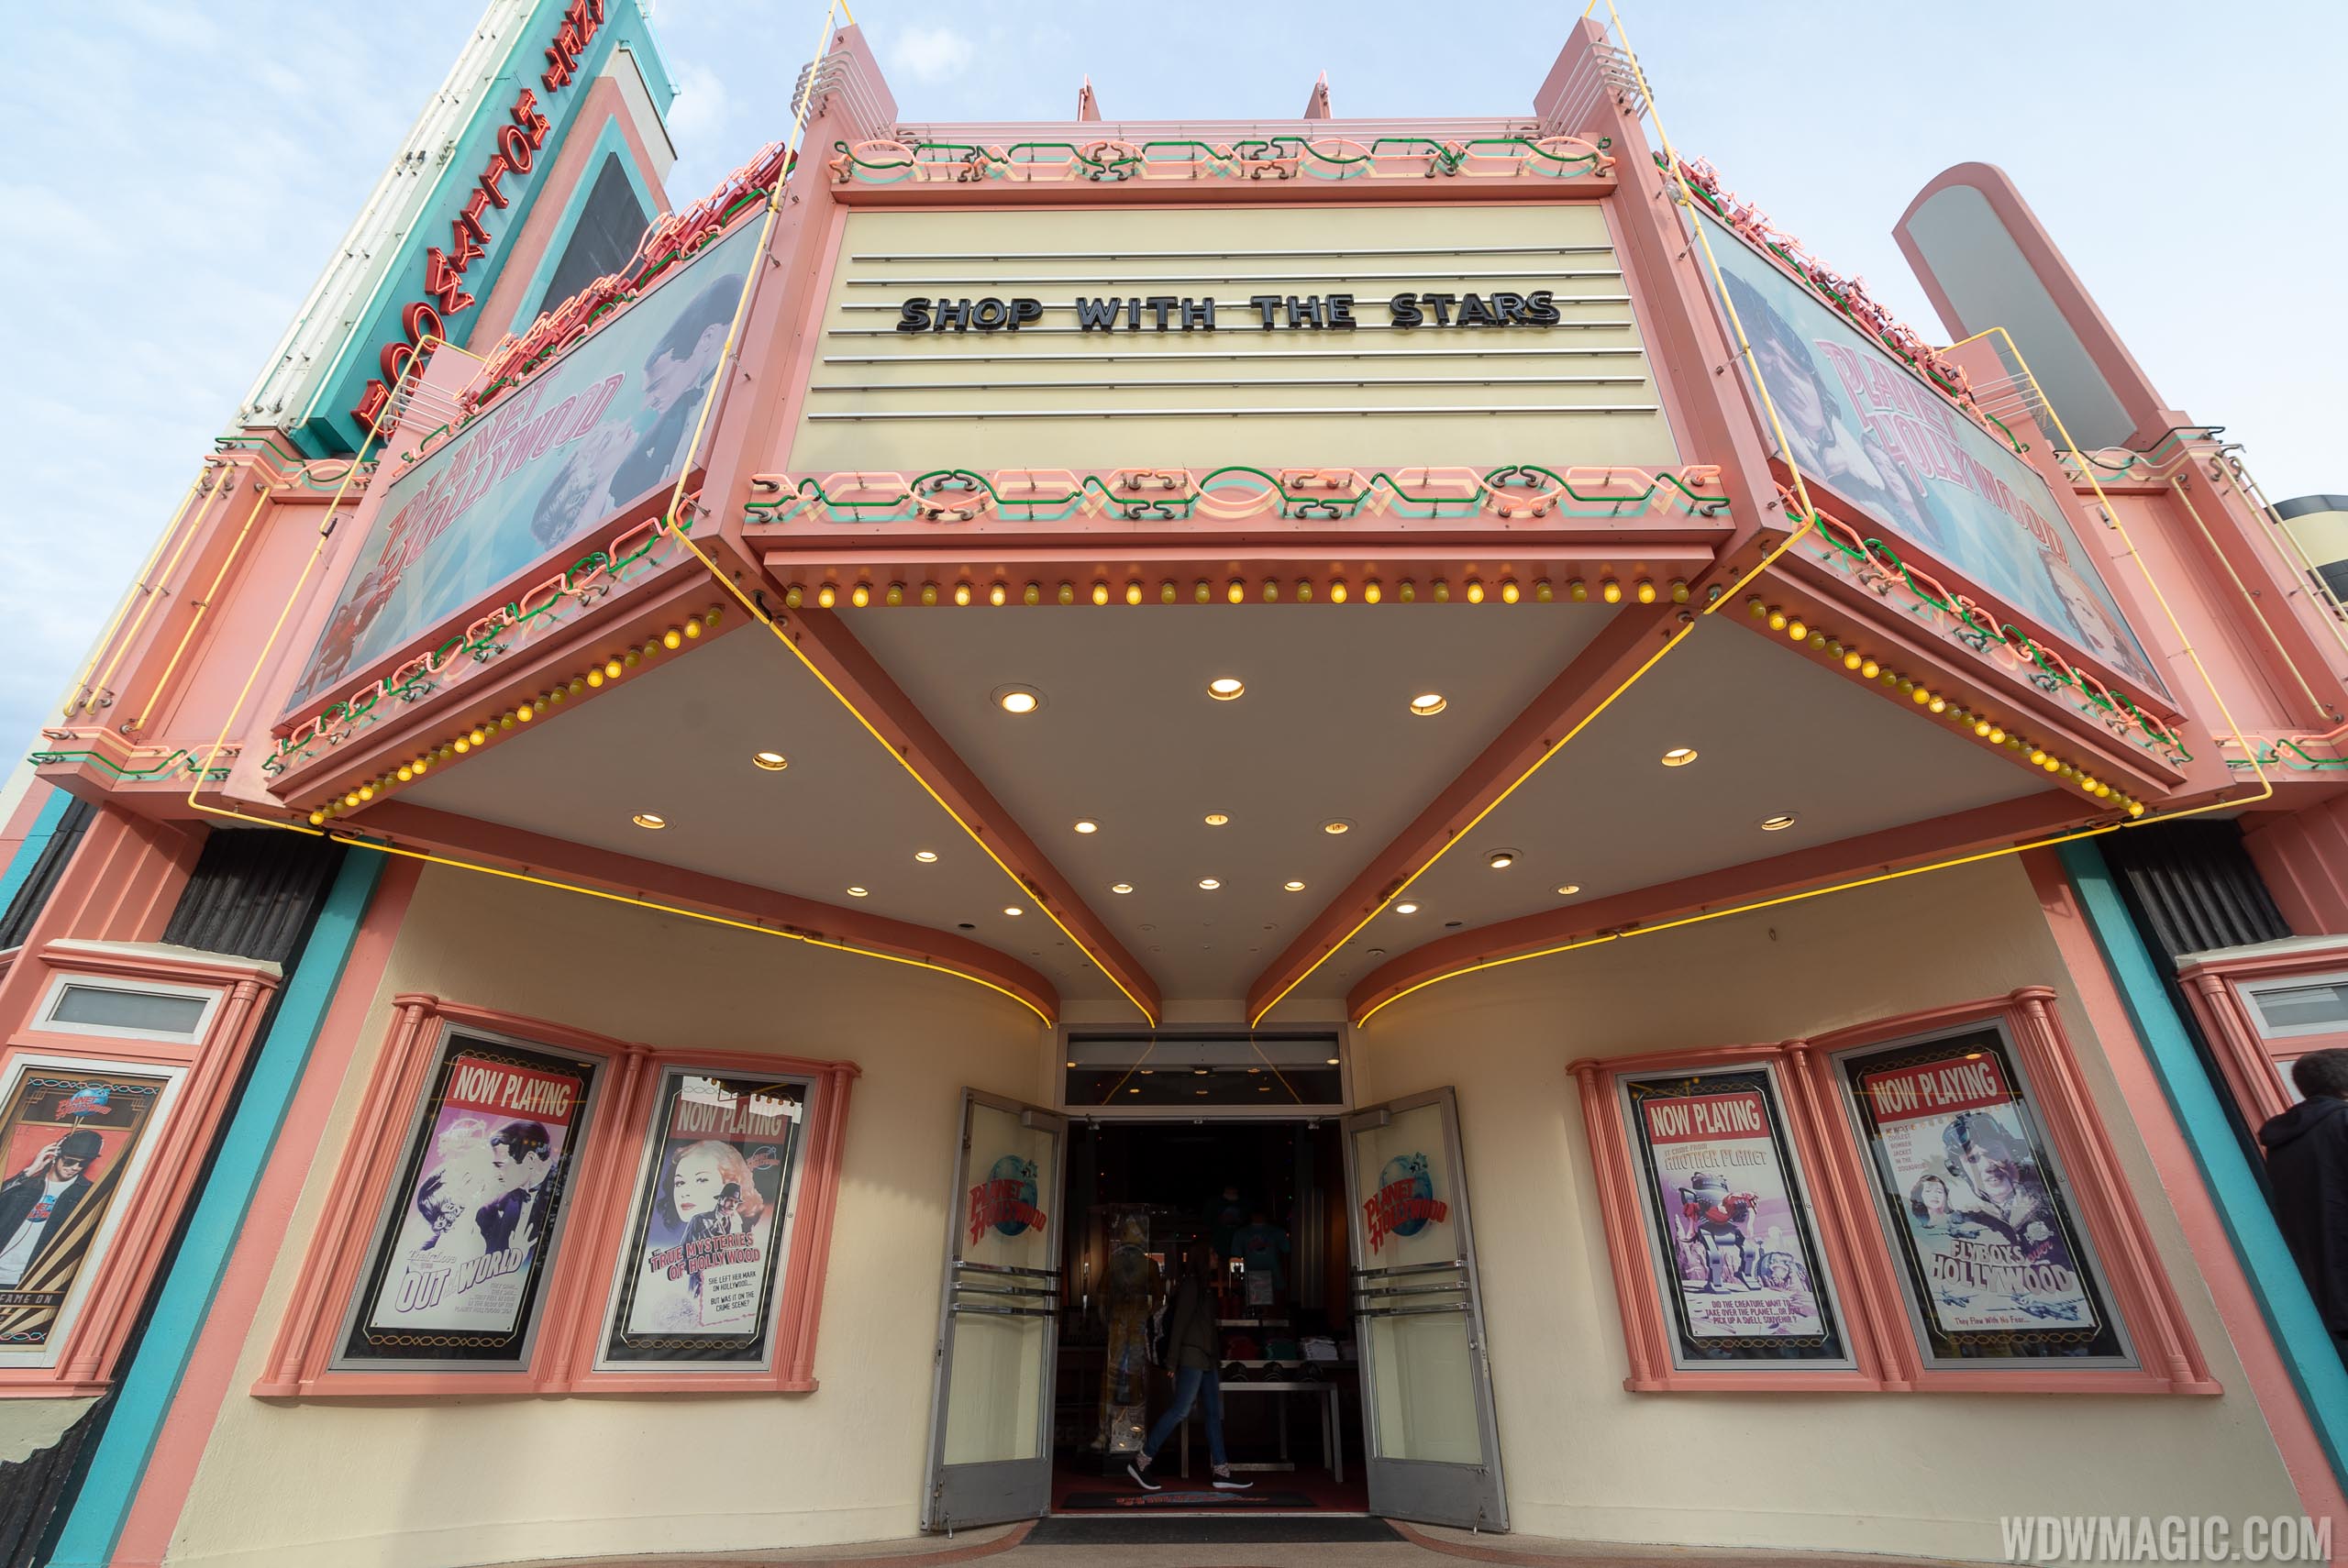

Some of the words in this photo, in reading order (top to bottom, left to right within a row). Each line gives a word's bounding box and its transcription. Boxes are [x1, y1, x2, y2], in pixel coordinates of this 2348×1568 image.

[896, 297, 1044, 333] SHOP
[1076, 296, 1216, 332] WITH
[1250, 293, 1357, 331] THE
[1390, 290, 1561, 327] STARS
[1813, 338, 1960, 444] PLANET
[377, 365, 564, 558] PLANET
[379, 372, 626, 587] HOLLYWOOD
[1866, 414, 2071, 568] HOLLYWOOD
[453, 1066, 504, 1105] NOW
[500, 1074, 571, 1117] PLAYING
[1872, 1076, 1920, 1115] NOW
[1917, 1061, 1999, 1108] PLAYING
[677, 1101, 719, 1132] NOW
[720, 1104, 782, 1137] PLAYING
[1651, 1104, 1691, 1137] NOW
[1692, 1099, 1761, 1134] PLAYING
[969, 1179, 1024, 1222] PLANET
[1364, 1177, 1416, 1234] PLANET
[969, 1200, 1047, 1247] HOLLYWOOD
[1370, 1198, 1447, 1255] HOLLYWOOD
[649, 1247, 683, 1273] TRUE
[686, 1232, 755, 1258] MYSTERIES
[668, 1262, 686, 1281] OF
[687, 1248, 760, 1275] HOLLYWOOD
[1951, 1239, 2026, 1264] FLYBOYS
[395, 1268, 451, 1312] OUT
[458, 1248, 523, 1294] WORLD
[719, 1275, 731, 1284] LEFT
[733, 1273, 742, 1281] HER
[1929, 1253, 2074, 1296] HOLLYWOOD
[0, 1294, 31, 1304] FAME
[36, 1294, 53, 1304] ON
[715, 1304, 730, 1312] CRIME
[732, 1299, 749, 1309] SCENE?
[721, 1295, 731, 1303] WAS
[1706, 1309, 1722, 1317] TAKE
[1722, 1309, 1738, 1317] OVER
[1738, 1309, 1750, 1317] THE
[1711, 1300, 1722, 1309] DID
[1723, 1300, 1733, 1309] THE
[1735, 1300, 1764, 1309] CREATURE
[1765, 1299, 1781, 1308] WANT
[1713, 1317, 1727, 1325] PICK
[1727, 1317, 1735, 1325] UP
[1744, 1317, 1763, 1325] SWELL
[1763, 1315, 1792, 1323] SOUVENIR
[1955, 1317, 1969, 1327] They
[1969, 1316, 1983, 1325] Flew
[1985, 1316, 1999, 1324] With
[1999, 1316, 2009, 1324] No
